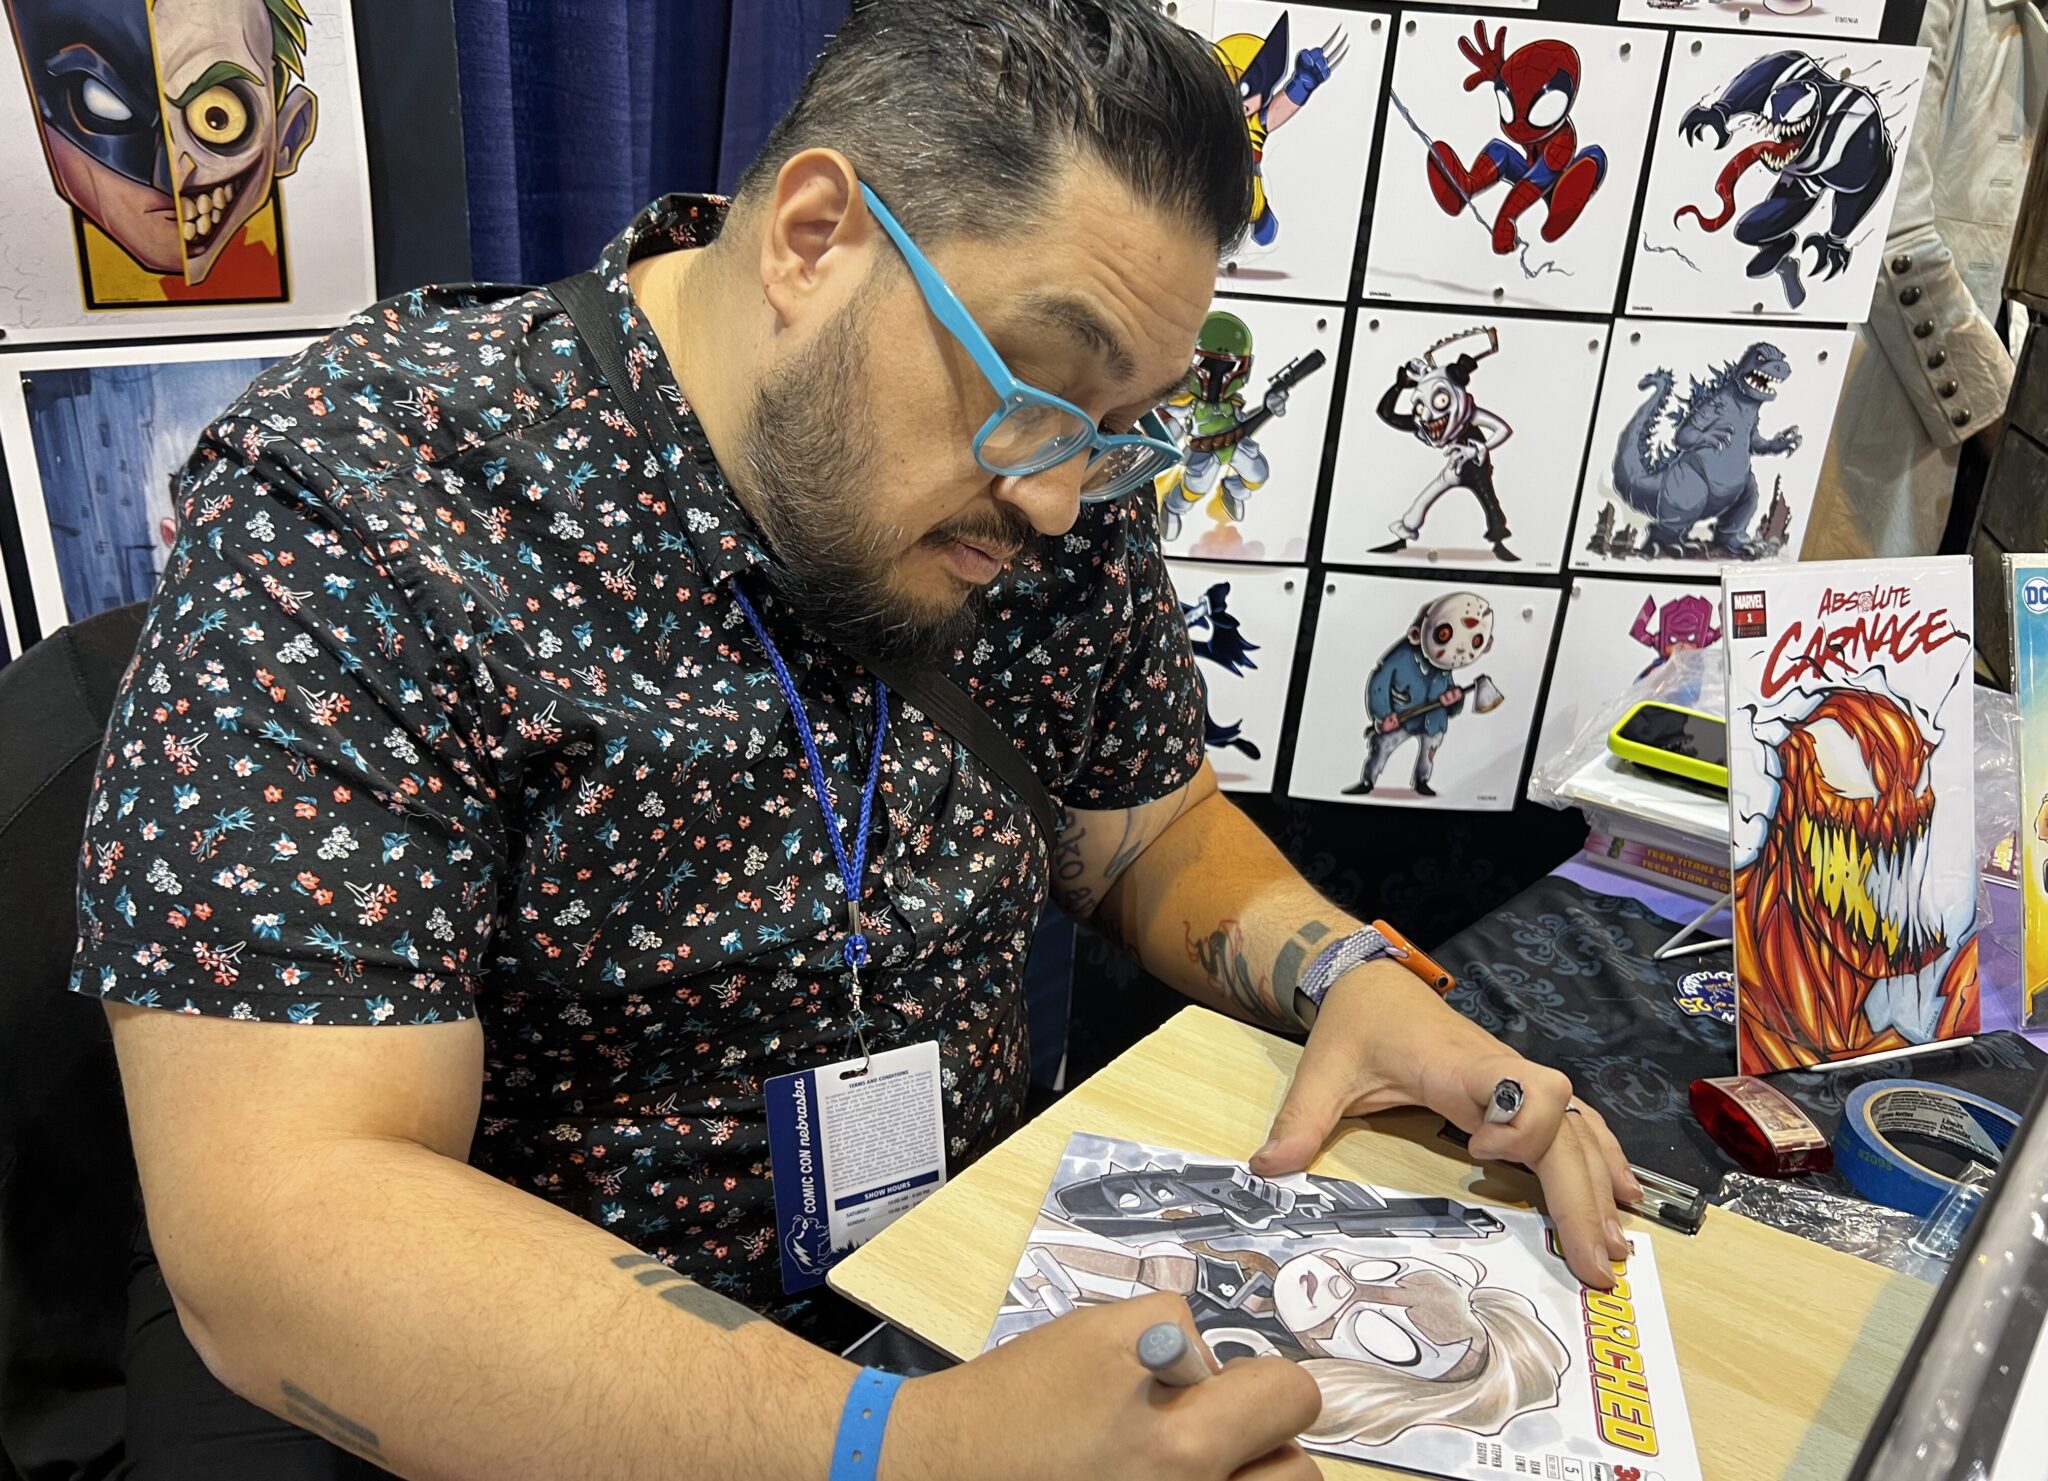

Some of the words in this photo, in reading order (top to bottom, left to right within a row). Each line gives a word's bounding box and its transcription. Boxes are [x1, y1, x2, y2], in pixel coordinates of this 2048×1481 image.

[1734, 593, 1764, 610] MARVEL
[1817, 584, 1911, 619] ABSOLUTE
[1747, 612, 1753, 623] 1
[1760, 608, 1957, 699] CARNAGE
[849, 1081, 866, 1089] TERMS
[866, 1077, 878, 1085] AND
[878, 1070, 909, 1082] CONDITIONS
[792, 1077, 811, 1147] nebraska
[798, 1149, 813, 1174] CON
[801, 1176, 817, 1214] COMIC
[864, 1188, 886, 1200] SHOW
[887, 1181, 911, 1194] HOURS
[846, 1207, 870, 1218] SATURDAY
[847, 1218, 866, 1227] SUNDAY
[1579, 1258, 1659, 1457] CORCHED
[1491, 1443, 1502, 1468] STEPHEN
[1564, 1466, 1580, 1475] 5
